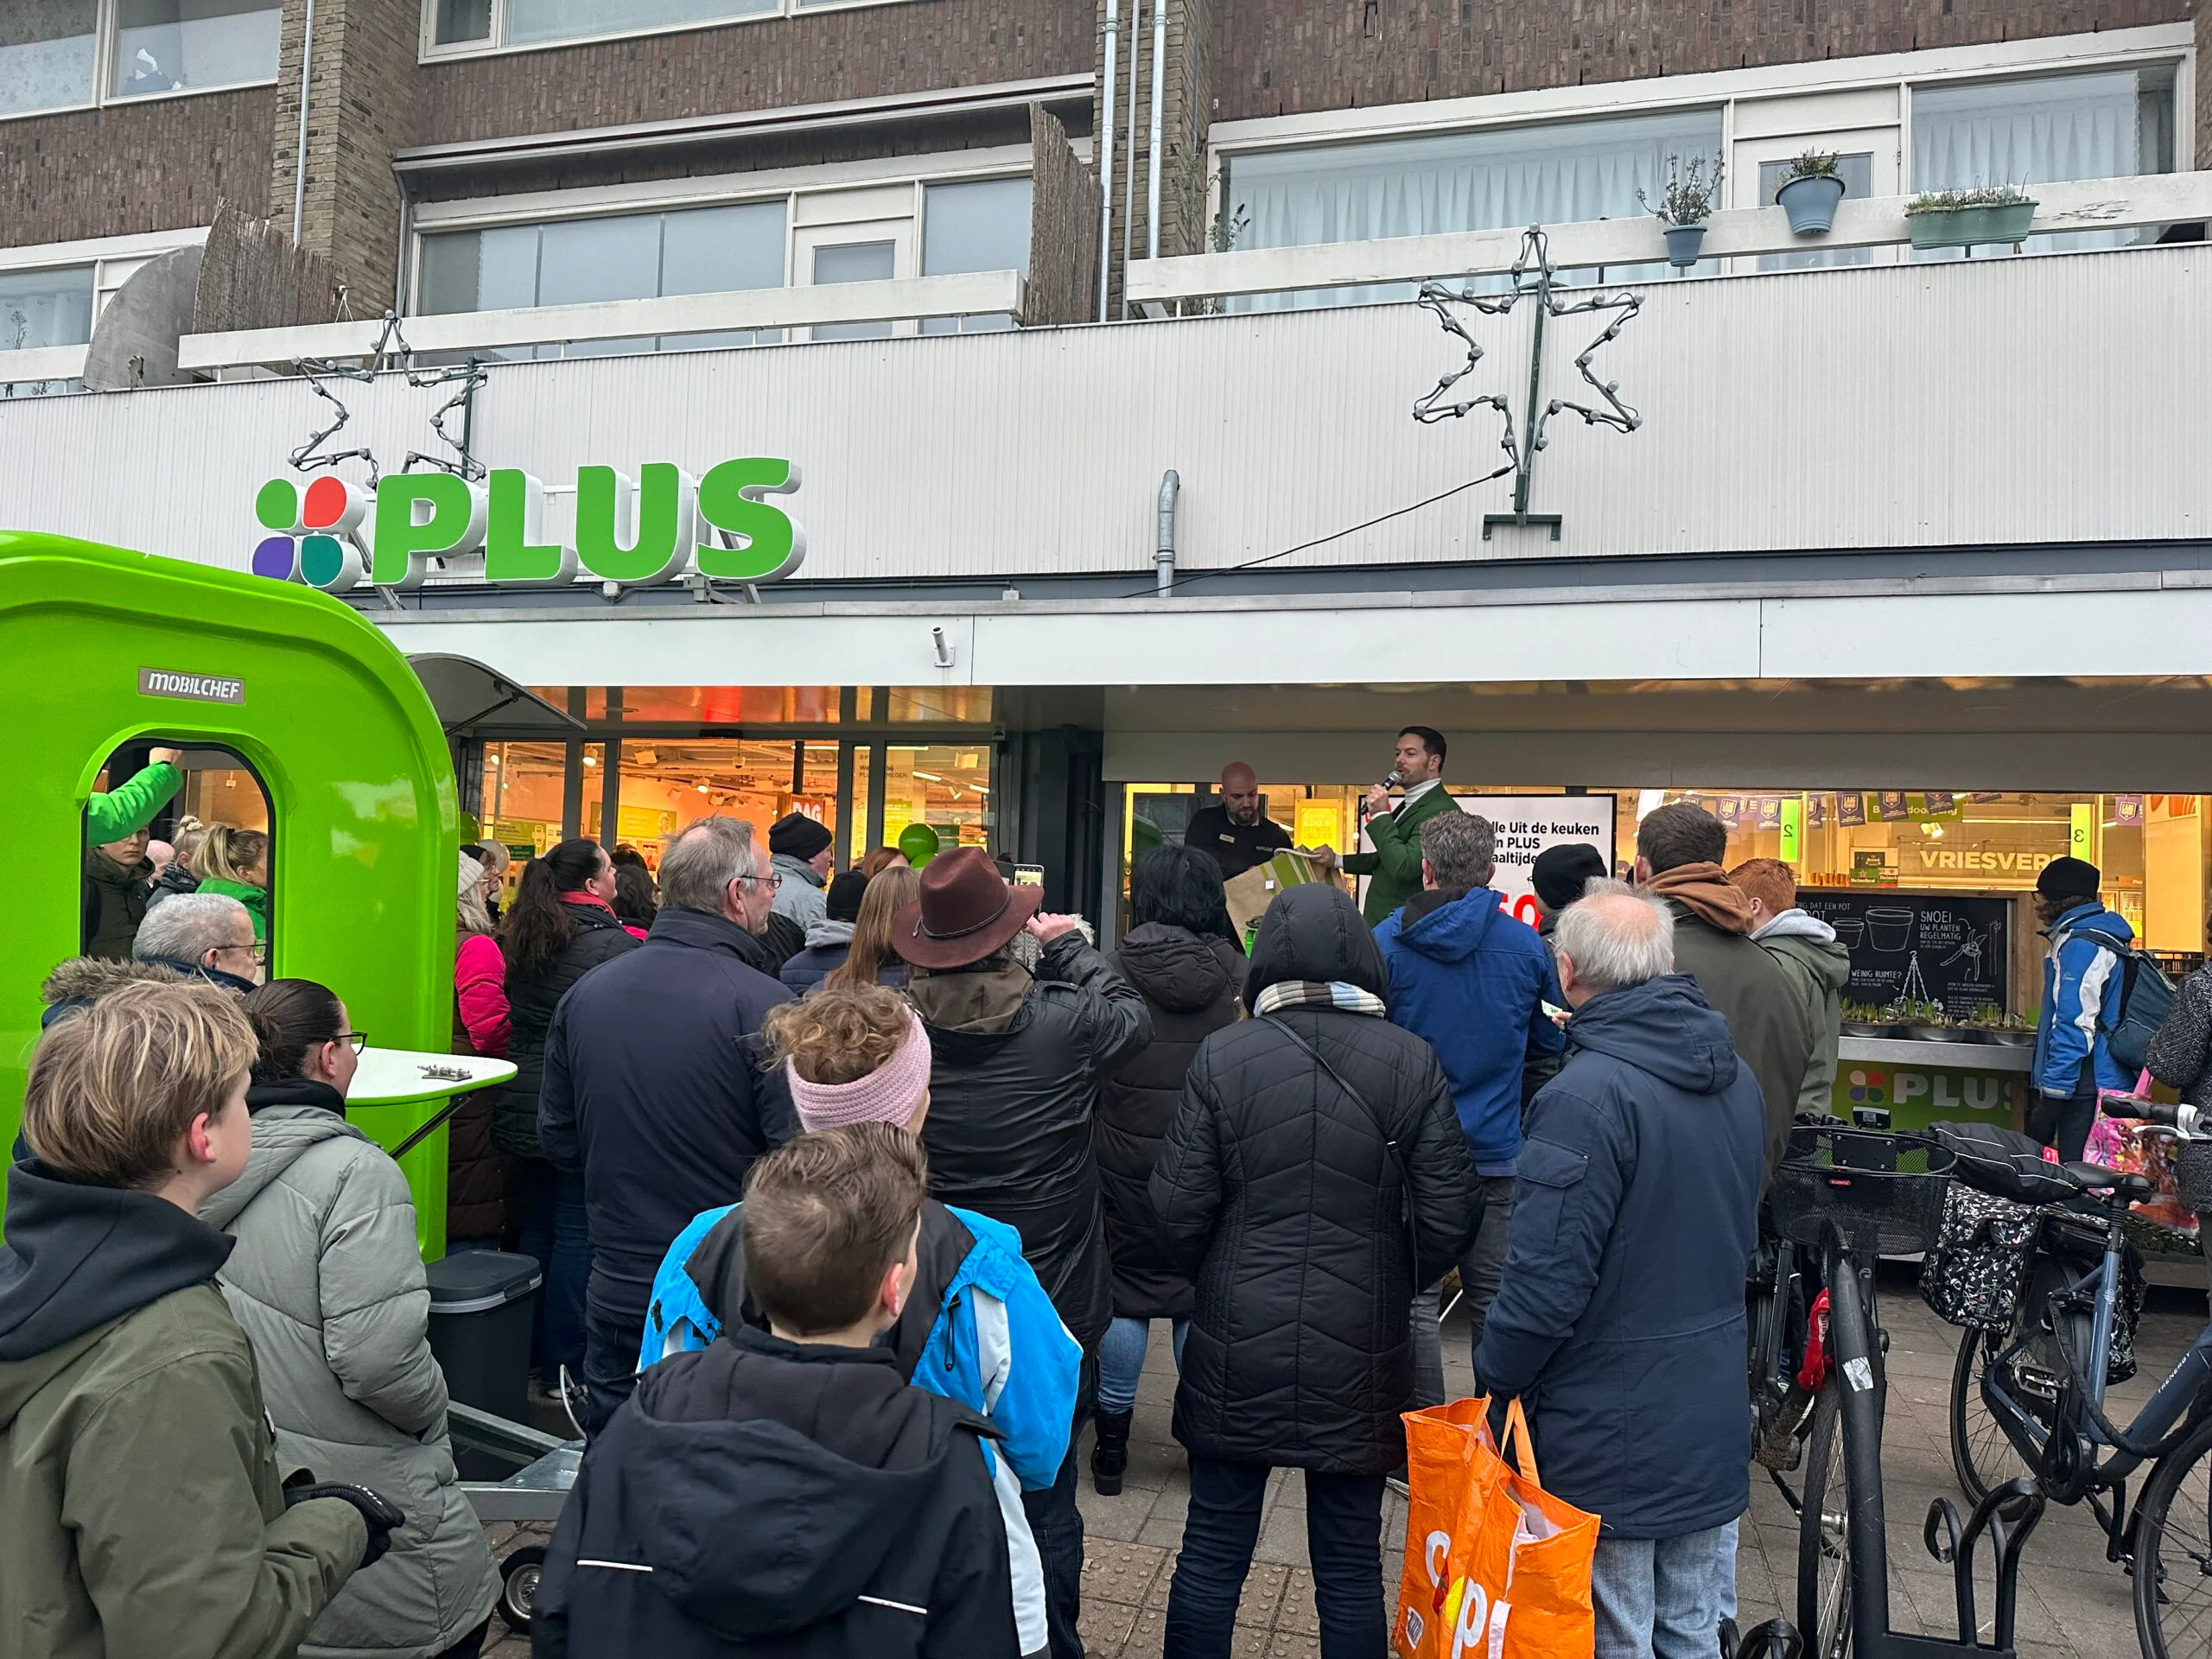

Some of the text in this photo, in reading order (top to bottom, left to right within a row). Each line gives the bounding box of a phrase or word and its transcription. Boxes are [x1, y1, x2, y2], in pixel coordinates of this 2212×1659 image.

[372, 456, 802, 586] PLUS
[1510, 822, 1528, 833] Uit
[1531, 822, 1548, 834] de
[1551, 823, 1599, 835] keuken
[1507, 836, 1541, 849] PLUS
[1491, 851, 1538, 866] aaltijde
[1919, 850, 2067, 870] VRIESVER
[1809, 901, 1821, 910] DAT
[1824, 901, 1837, 910] EEN
[1839, 902, 1851, 911] POT
[1920, 910, 1952, 923] SNOEI
[1920, 923, 1961, 932] UW PLANTEN
[1919, 931, 1961, 940] REGELMATIG
[1851, 969, 1903, 979] WEINIG RUIMTE?
